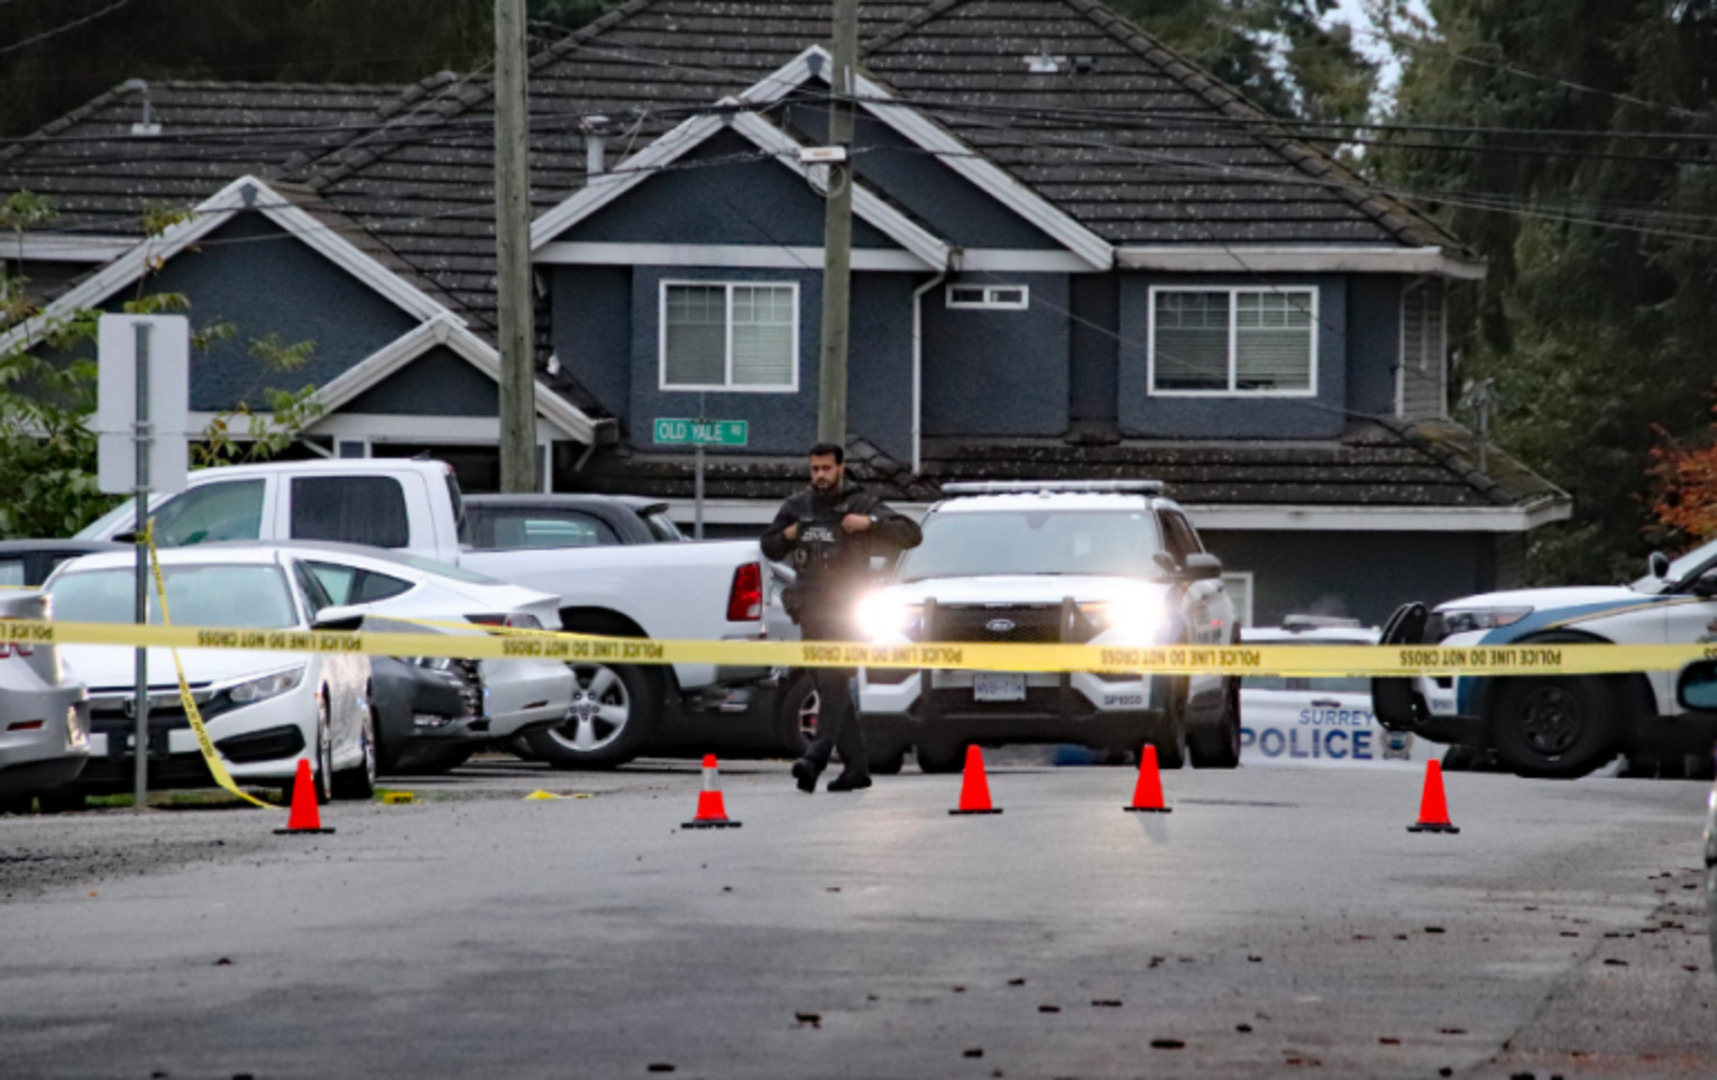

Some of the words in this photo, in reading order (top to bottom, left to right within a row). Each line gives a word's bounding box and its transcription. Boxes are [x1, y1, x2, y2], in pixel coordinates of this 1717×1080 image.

[659, 422, 687, 440] OLD
[692, 423, 723, 441] YALE
[10, 624, 52, 640] POLICE
[198, 630, 237, 647] CROSS
[241, 632, 265, 648] NOT
[269, 633, 285, 648] DO
[289, 633, 316, 649] LINE
[320, 634, 361, 651] POLICE
[503, 640, 542, 656] CROSS
[546, 640, 568, 656] NOT
[573, 641, 588, 657] DO
[593, 642, 618, 657] LINE
[622, 643, 663, 658] POLICE
[1101, 650, 1139, 665] CROSS
[1143, 650, 1165, 665] NOT
[1170, 650, 1186, 665] DO
[1190, 650, 1216, 666] LINE
[1220, 650, 1260, 666] POLICE
[1400, 650, 1438, 666] CROSS
[1442, 650, 1466, 666] NOT
[1470, 650, 1486, 665] DO
[1490, 650, 1516, 665] LINE
[1520, 650, 1561, 665] POLICE
[1299, 710, 1374, 726] SURREY
[1237, 727, 1373, 760] POLICE
